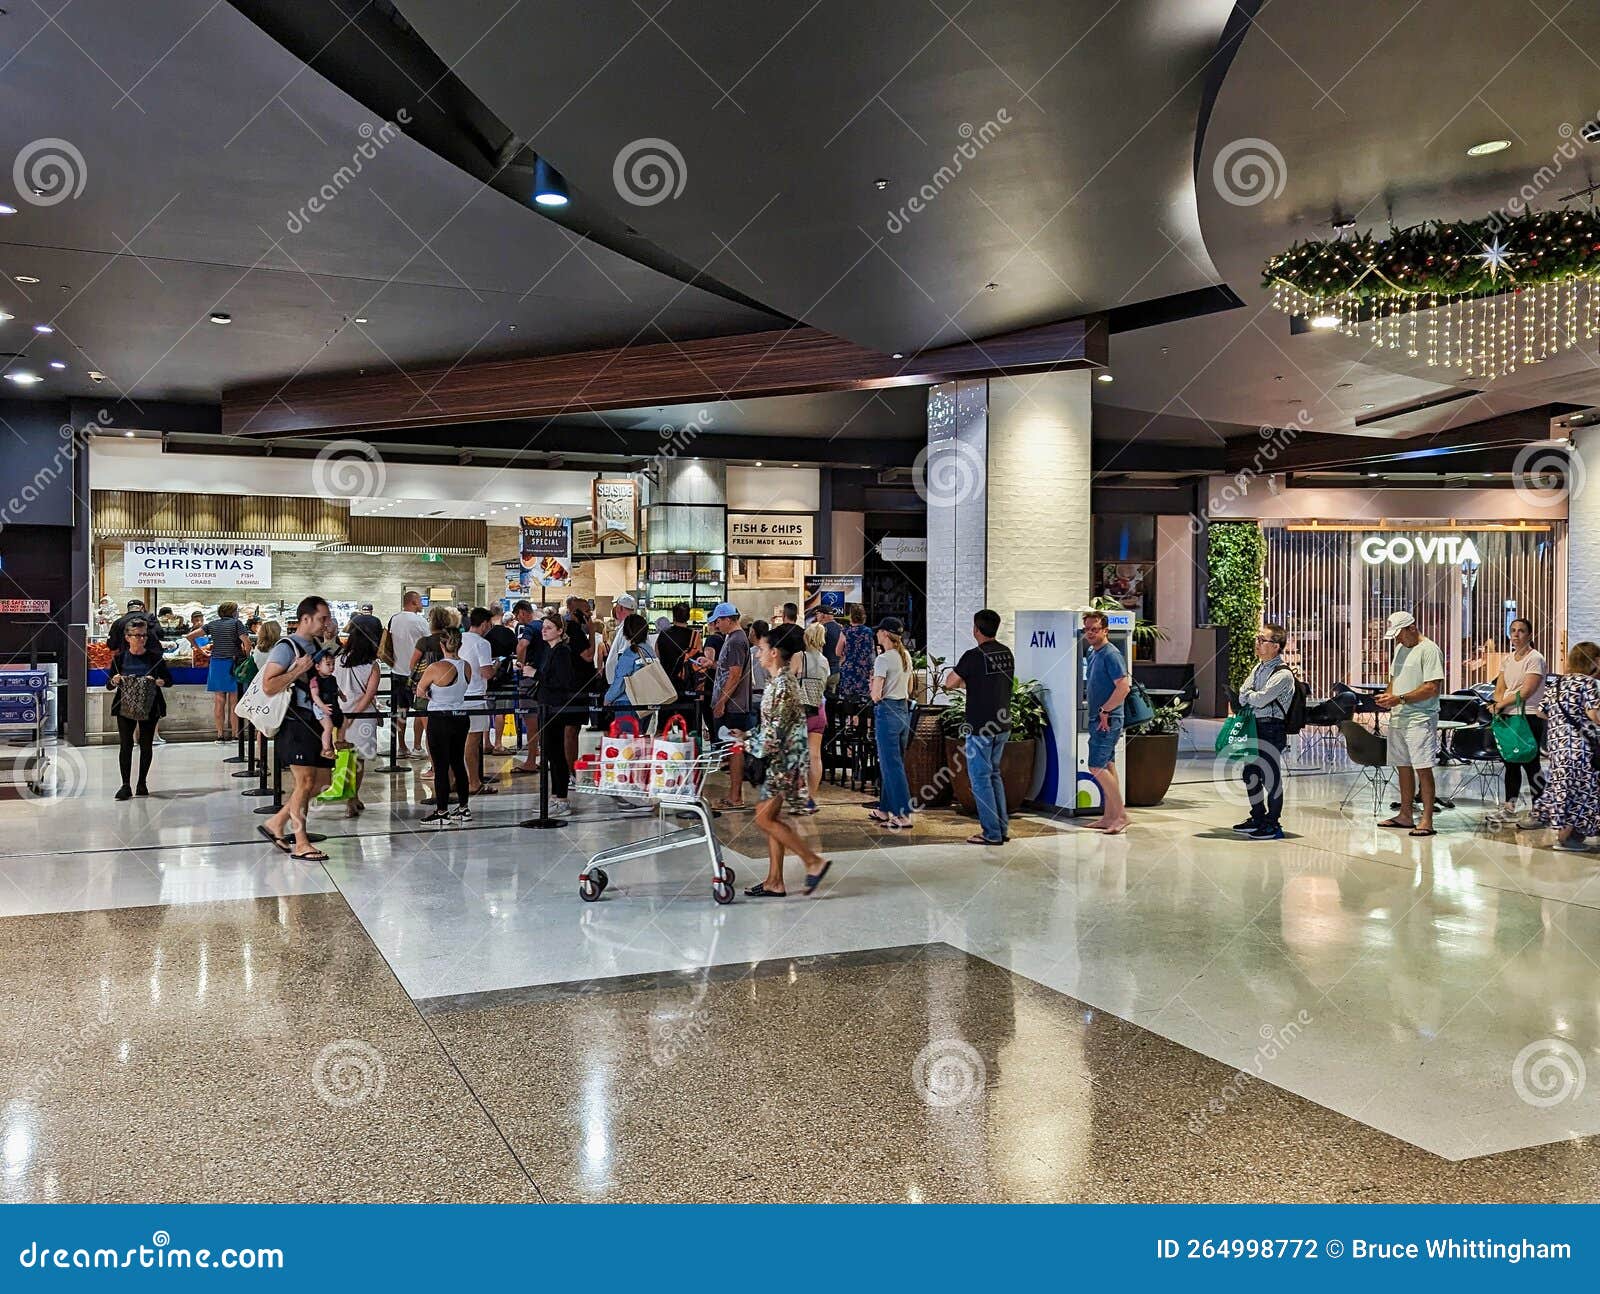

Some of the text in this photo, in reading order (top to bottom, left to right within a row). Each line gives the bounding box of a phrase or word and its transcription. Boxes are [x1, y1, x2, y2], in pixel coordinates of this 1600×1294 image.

[597, 484, 634, 498] SEASIDE
[733, 524, 803, 534] FISH & CHIPS
[531, 538, 559, 546] SPECIAL
[134, 546, 189, 556] ORDER
[193, 547, 228, 556] NOW
[234, 548, 264, 557] FOR
[144, 558, 254, 570] CHRISTMAS
[1029, 631, 1056, 649] ATM
